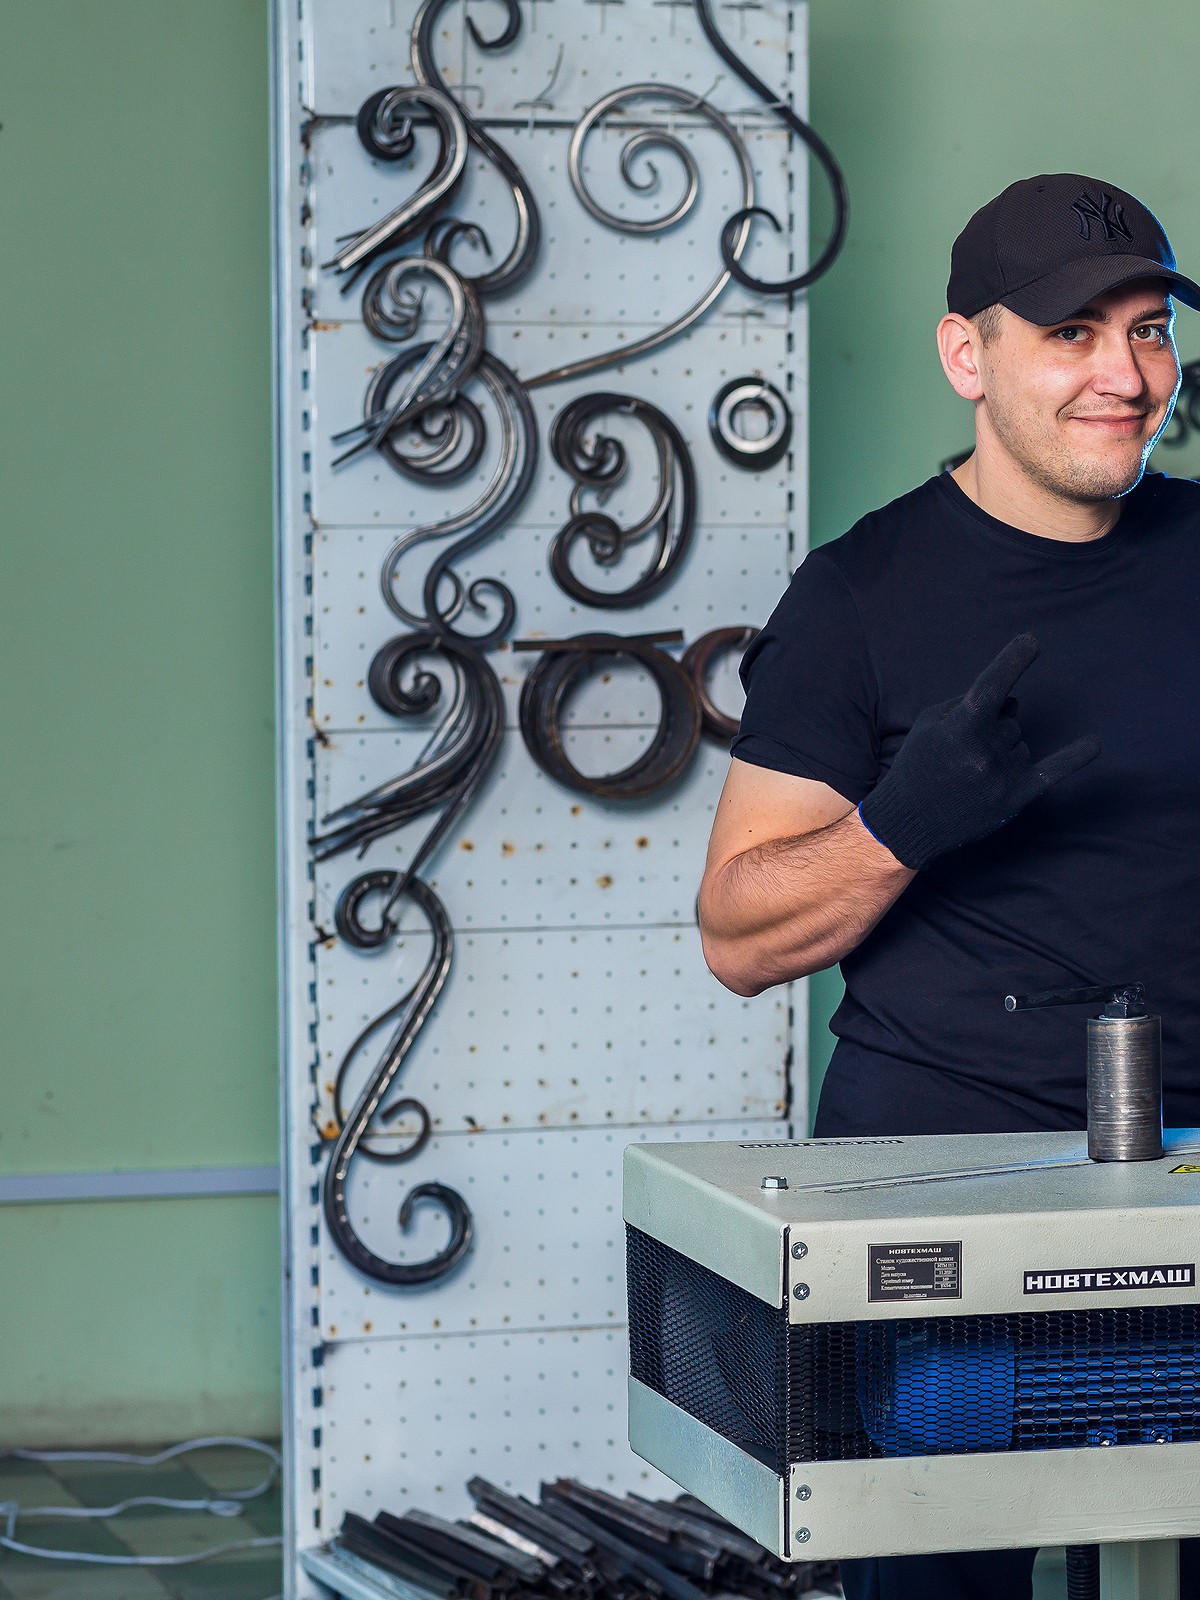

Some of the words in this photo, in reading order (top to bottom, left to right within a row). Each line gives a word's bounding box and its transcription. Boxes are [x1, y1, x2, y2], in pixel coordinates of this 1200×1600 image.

[1070, 191, 1134, 242] NY
[888, 1247, 942, 1255] НОВТЕХМАШ
[1026, 1269, 1191, 1290] НОВТЕХМАШ
